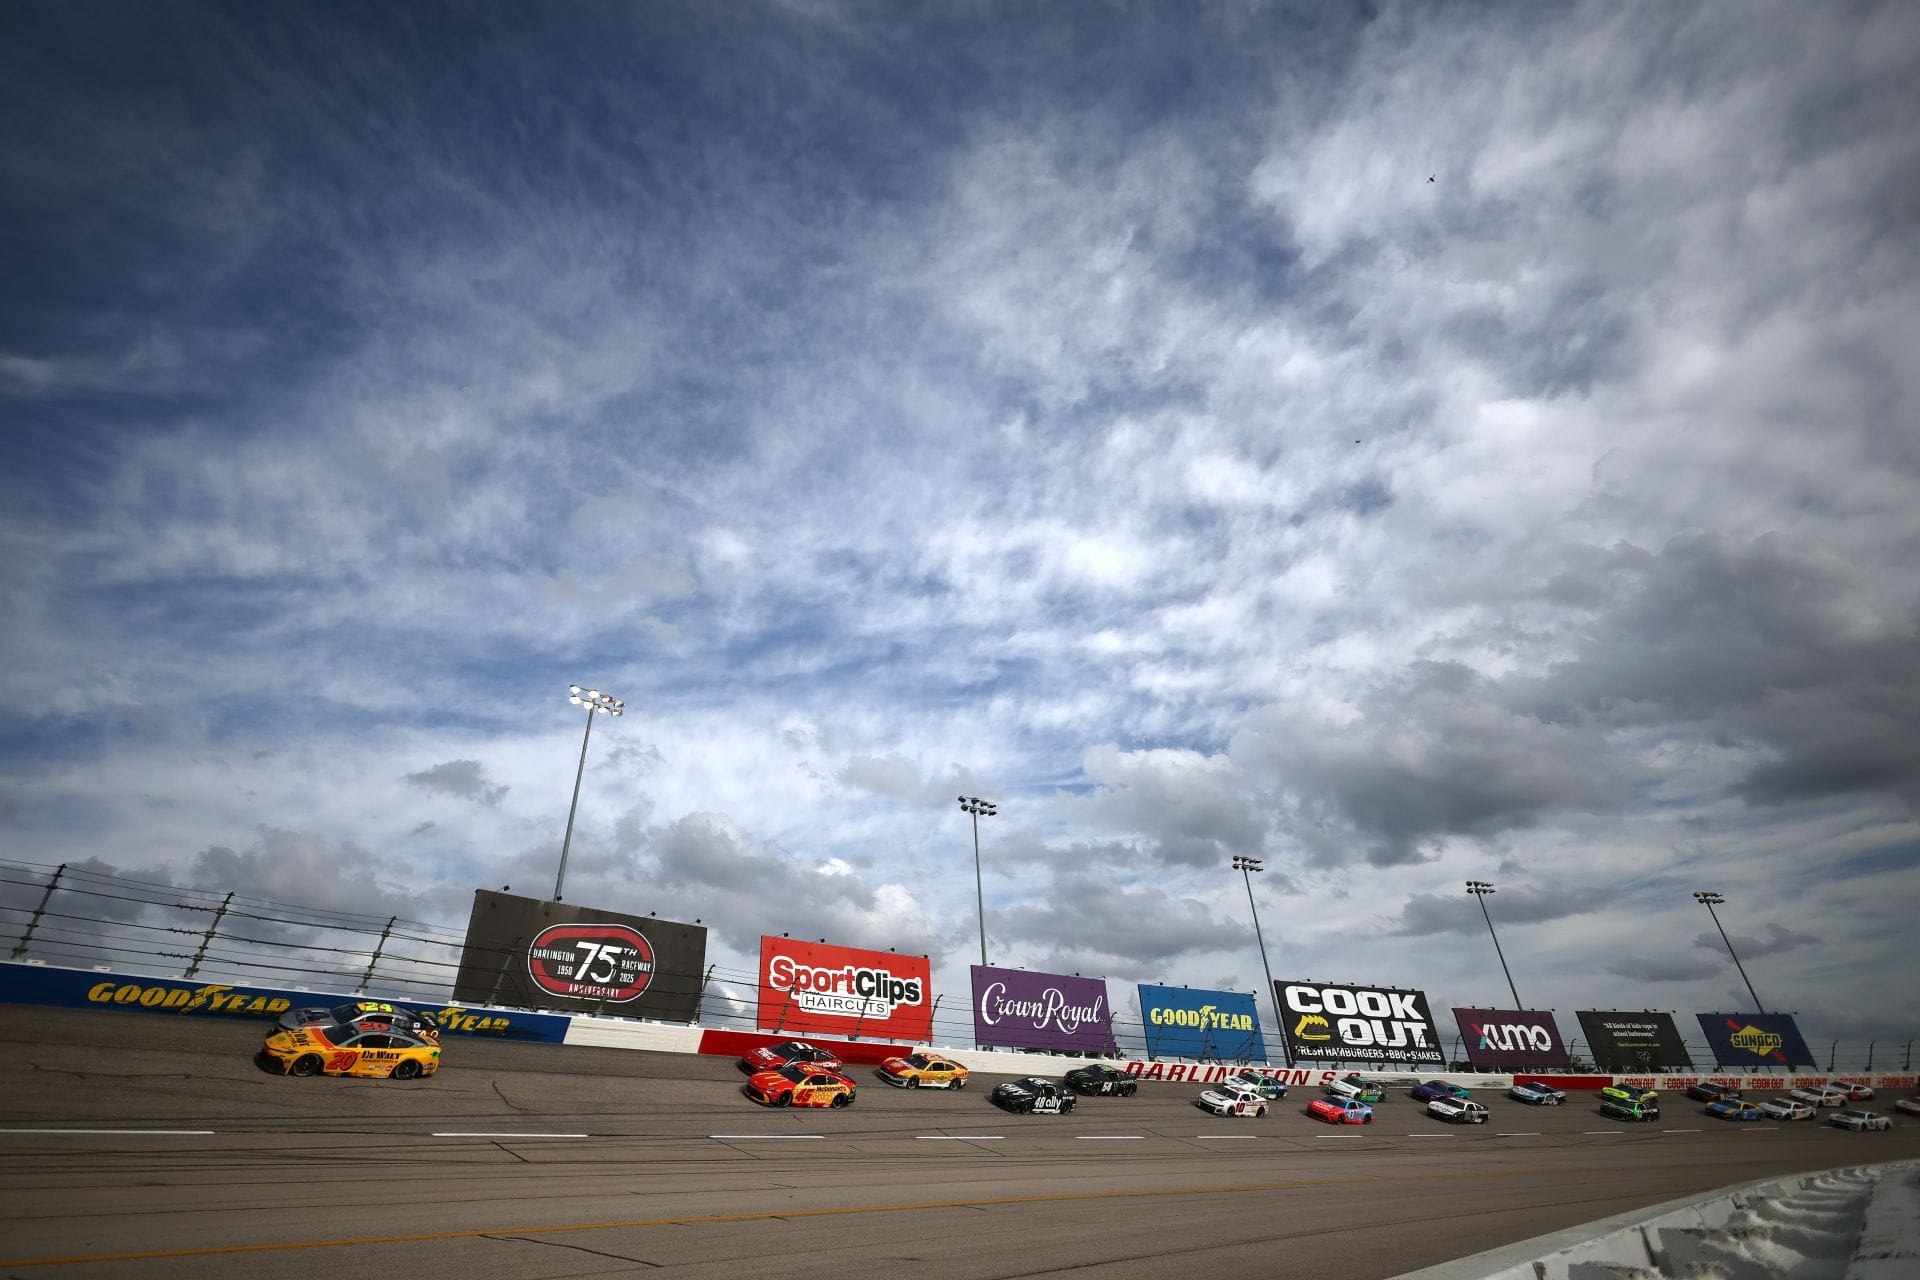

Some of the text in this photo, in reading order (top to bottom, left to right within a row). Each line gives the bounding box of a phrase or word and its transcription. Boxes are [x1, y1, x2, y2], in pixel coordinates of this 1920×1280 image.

[533, 948, 575, 962] DARLINGTON
[557, 965, 573, 975] 1950
[621, 959, 651, 972] RACEWAY
[619, 972, 635, 983] 2025
[568, 983, 620, 998] ANNIVERSARY
[365, 1002, 393, 1013] 24
[804, 995, 886, 1014] HAIRCUTS
[981, 982, 1103, 1035] Crown Royal
[1285, 985, 1425, 1020] COOK
[359, 1021, 389, 1032] 20
[1337, 1017, 1428, 1048] OUT
[1732, 1034, 1781, 1047] SUNOCO
[1325, 1046, 1385, 1059] HAMBURGERS
[1411, 1050, 1442, 1061] SHAKES
[326, 1050, 358, 1072] 20
[1034, 1095, 1062, 1110] 48 ally
[1235, 1102, 1246, 1114] 10
